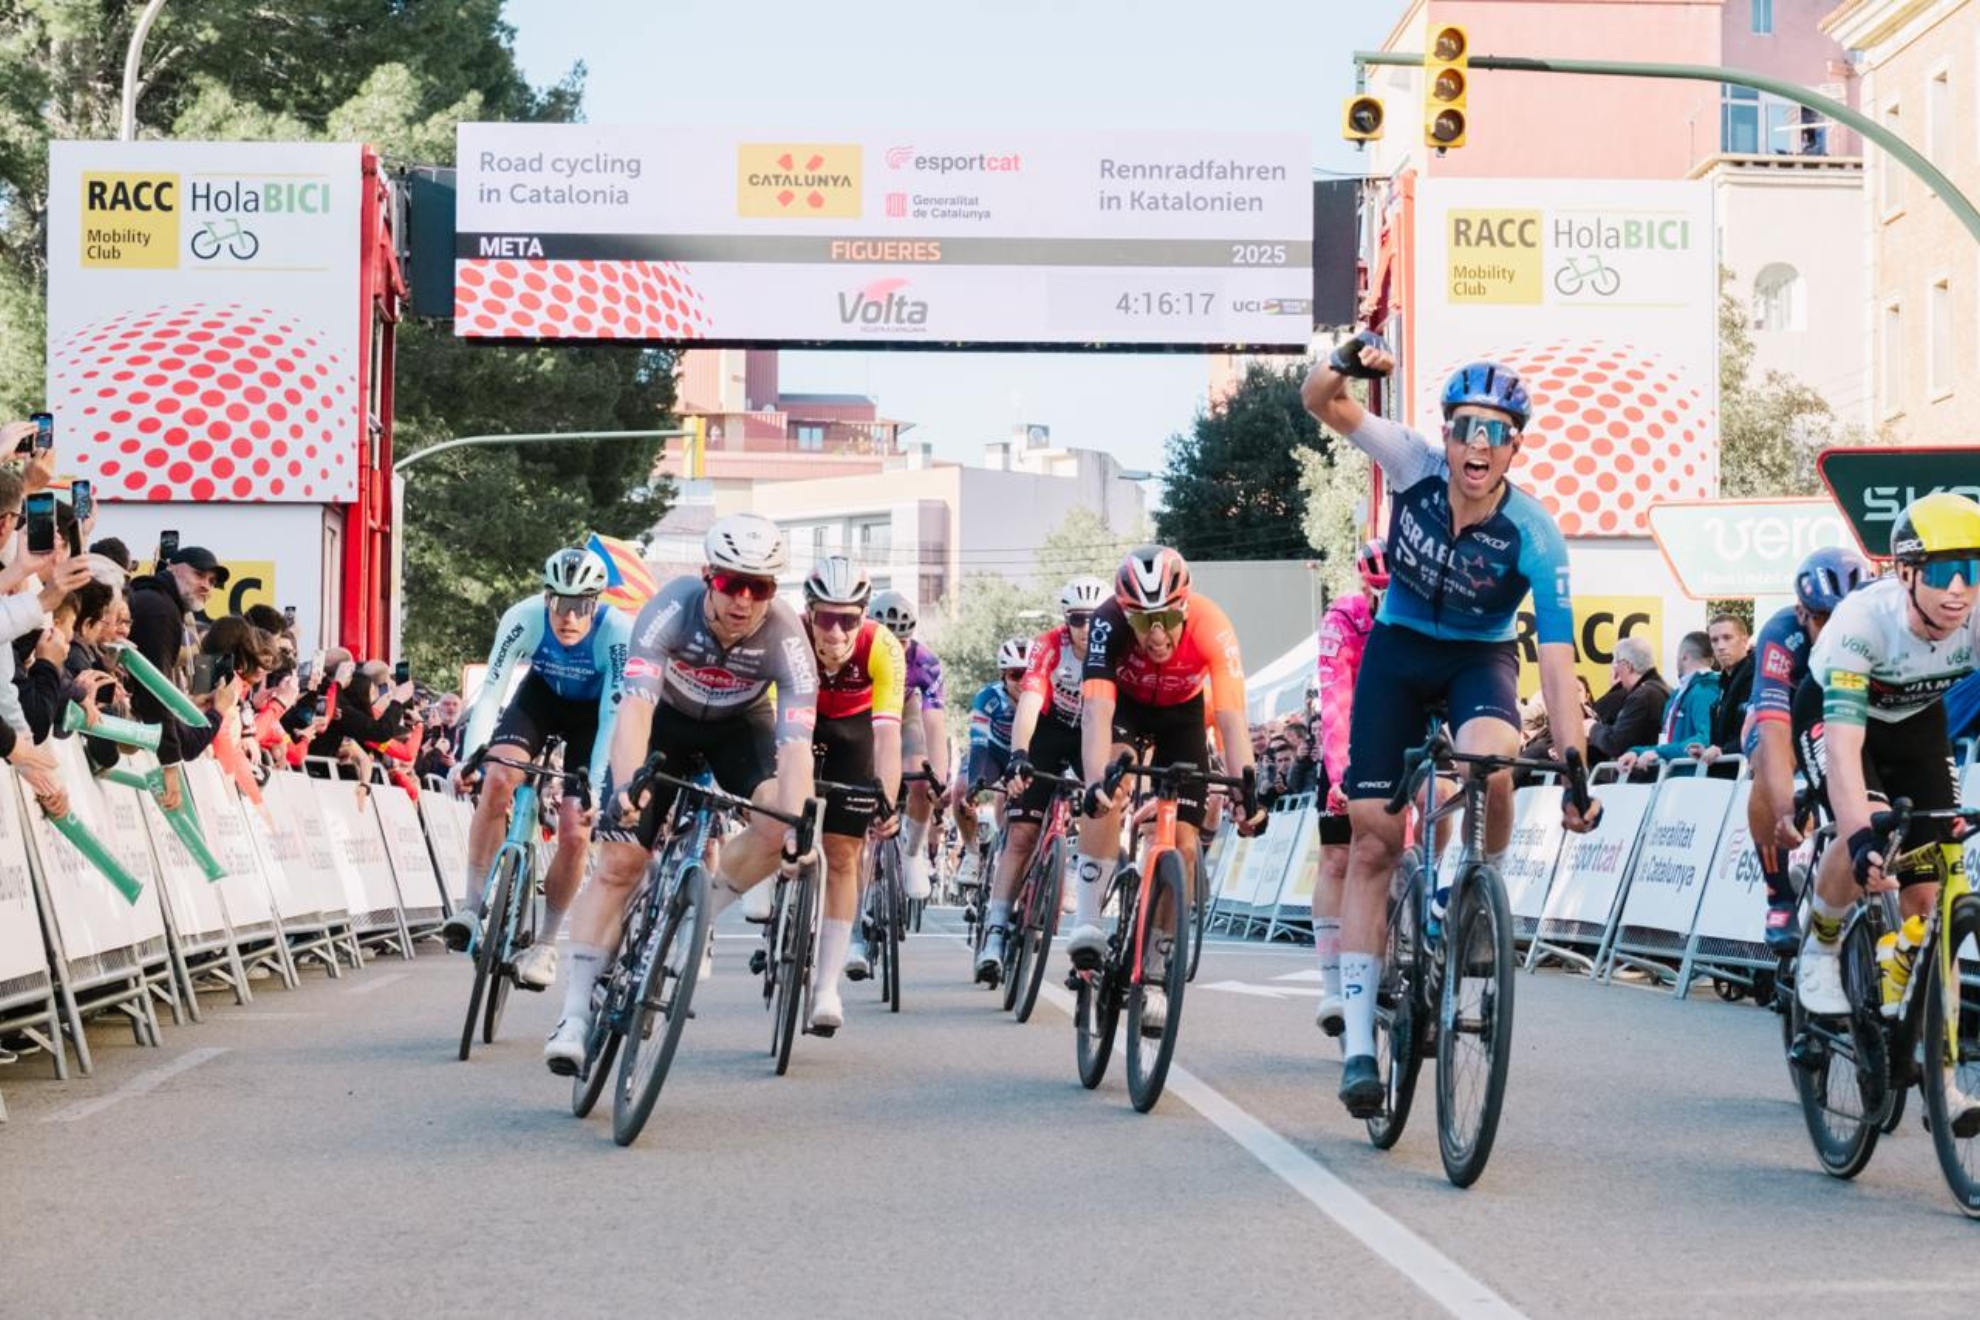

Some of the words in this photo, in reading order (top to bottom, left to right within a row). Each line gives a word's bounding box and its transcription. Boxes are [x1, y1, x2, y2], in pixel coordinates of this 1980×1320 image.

[480, 151, 543, 174] Road
[551, 153, 642, 179] cycling
[914, 151, 1022, 175] esportcat
[1100, 158, 1287, 182] Rennradfahren
[748, 174, 852, 188] CATALUNYA
[88, 180, 174, 212] RACC
[479, 183, 504, 204] in
[510, 183, 630, 206] Catalonia
[912, 194, 979, 207] Generalitat
[1100, 189, 1122, 211] in
[1130, 190, 1264, 212] Katalonien
[912, 207, 928, 219] de
[930, 207, 991, 220] Catalunya
[87, 228, 152, 247] Mobility
[1453, 217, 1537, 249] RACC
[87, 245, 122, 260] Club
[479, 237, 544, 258] META
[831, 240, 942, 262] FIGUERES
[1231, 245, 1287, 265] 2025
[1453, 264, 1516, 284] Mobility
[1453, 281, 1487, 297] Club
[837, 291, 930, 325] Volta
[1115, 291, 1216, 316] 4:16:17
[1232, 300, 1261, 313] UCI
[1399, 503, 1458, 571] ISRAEL
[1088, 617, 1113, 668] INEOS
